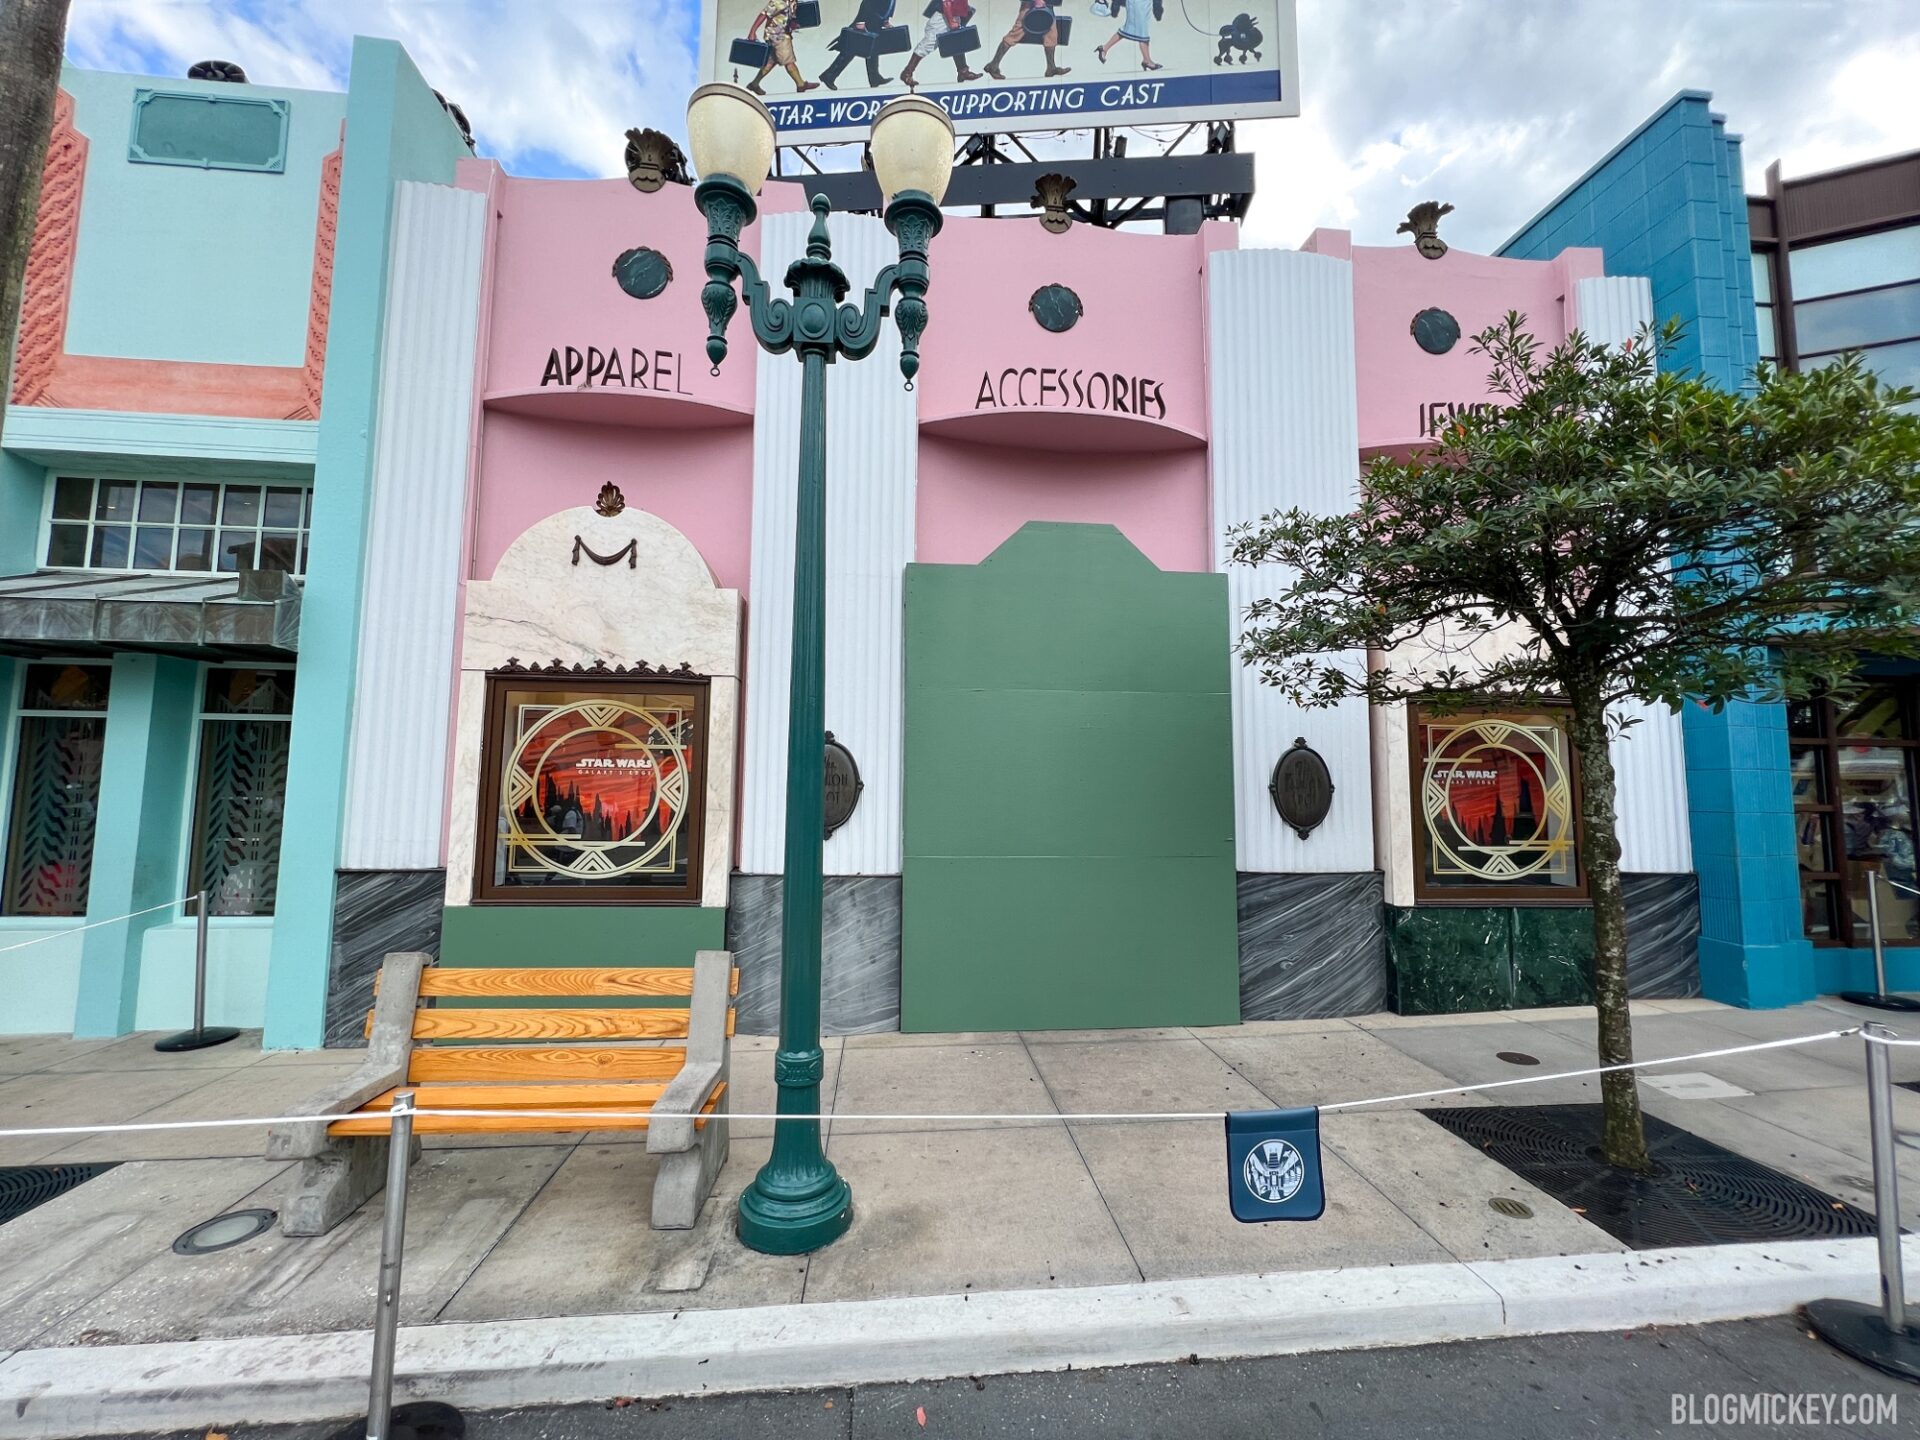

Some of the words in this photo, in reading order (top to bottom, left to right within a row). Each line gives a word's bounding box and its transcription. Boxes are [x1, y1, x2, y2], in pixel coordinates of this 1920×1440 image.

[767, 100, 888, 126] STAR-WOR
[939, 87, 1085, 114] SUPPORTING
[1101, 83, 1165, 107] CAST
[540, 346, 694, 396] APPAREL
[975, 367, 1167, 420] ACCESSORIES
[575, 758, 615, 768] STAR
[615, 758, 652, 769] WARS
[1466, 770, 1498, 779] WARS
